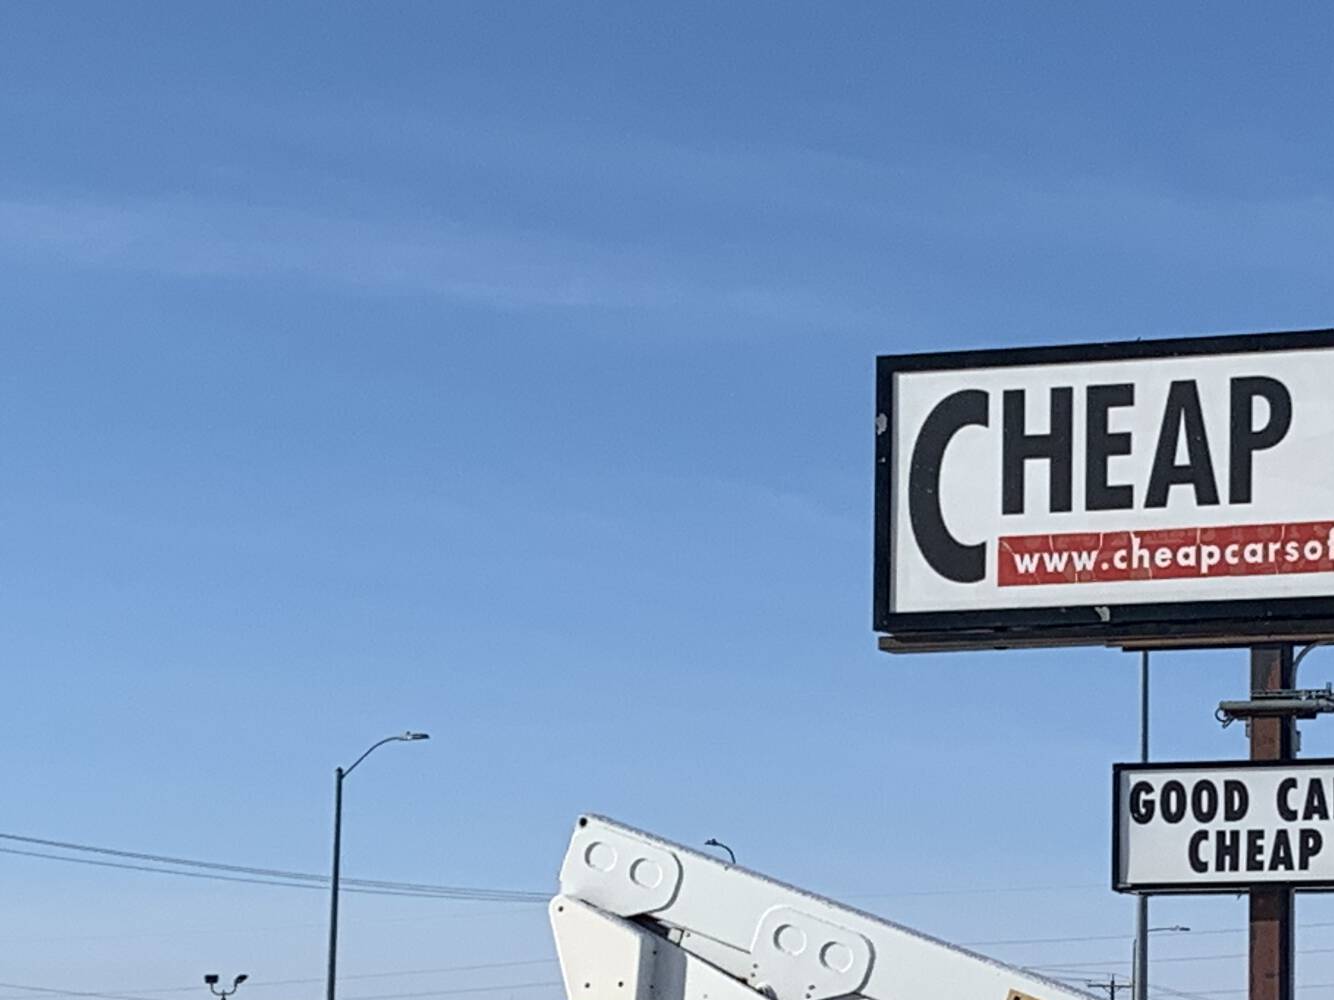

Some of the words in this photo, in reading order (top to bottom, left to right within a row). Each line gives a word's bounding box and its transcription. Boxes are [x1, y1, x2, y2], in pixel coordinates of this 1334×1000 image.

[908, 376, 1293, 584] CHEAP
[1129, 779, 1249, 825] GOOD
[1188, 828, 1323, 873] CHEAP
